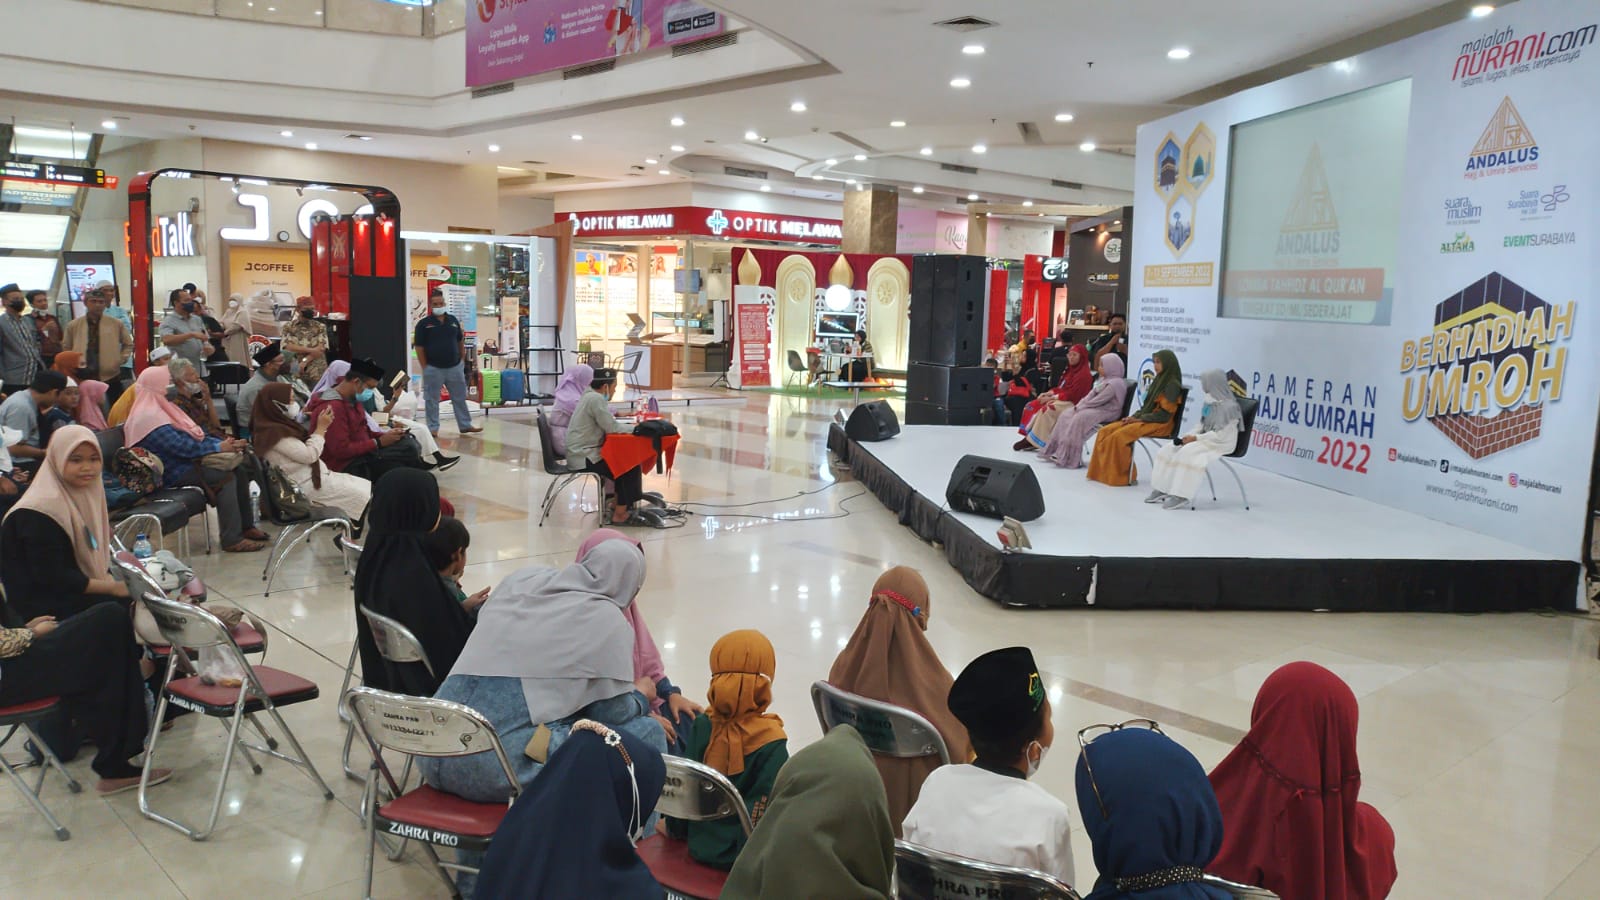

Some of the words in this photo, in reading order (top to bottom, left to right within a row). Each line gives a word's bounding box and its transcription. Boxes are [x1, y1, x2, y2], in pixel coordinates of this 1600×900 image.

[1460, 25, 1514, 55] majalah
[1465, 146, 1539, 171] ANDALUS
[1444, 196, 1470, 210] suara
[1507, 199, 1539, 210] Surabaya
[1520, 190, 1540, 200] Suara
[582, 216, 614, 231] OPTIK
[616, 214, 673, 230] MELAWAI
[1447, 205, 1482, 220] muslim
[733, 216, 777, 234] OPTIK
[780, 220, 842, 238] MELAWA
[1275, 231, 1340, 255] ANDALUS
[1503, 231, 1576, 248] EVENTSURABAYA
[1303, 303, 1352, 319] SEDERAJAT
[1400, 299, 1575, 374] BERHADIAH
[1253, 371, 1377, 409] PAMERAN
[1402, 346, 1567, 422] UMROH
[1252, 393, 1284, 422] HAJI
[1288, 400, 1300, 425] &
[1304, 402, 1375, 439] UMRAH
[1317, 436, 1371, 474] 2022
[1518, 478, 1562, 495] majalahnurani
[1425, 484, 1519, 513] www.majalahnurani.com
[169, 694, 191, 710] ZAHRA
[190, 702, 205, 714] PRO
[389, 821, 430, 841] ZAHRA
[433, 831, 458, 846] PRO
